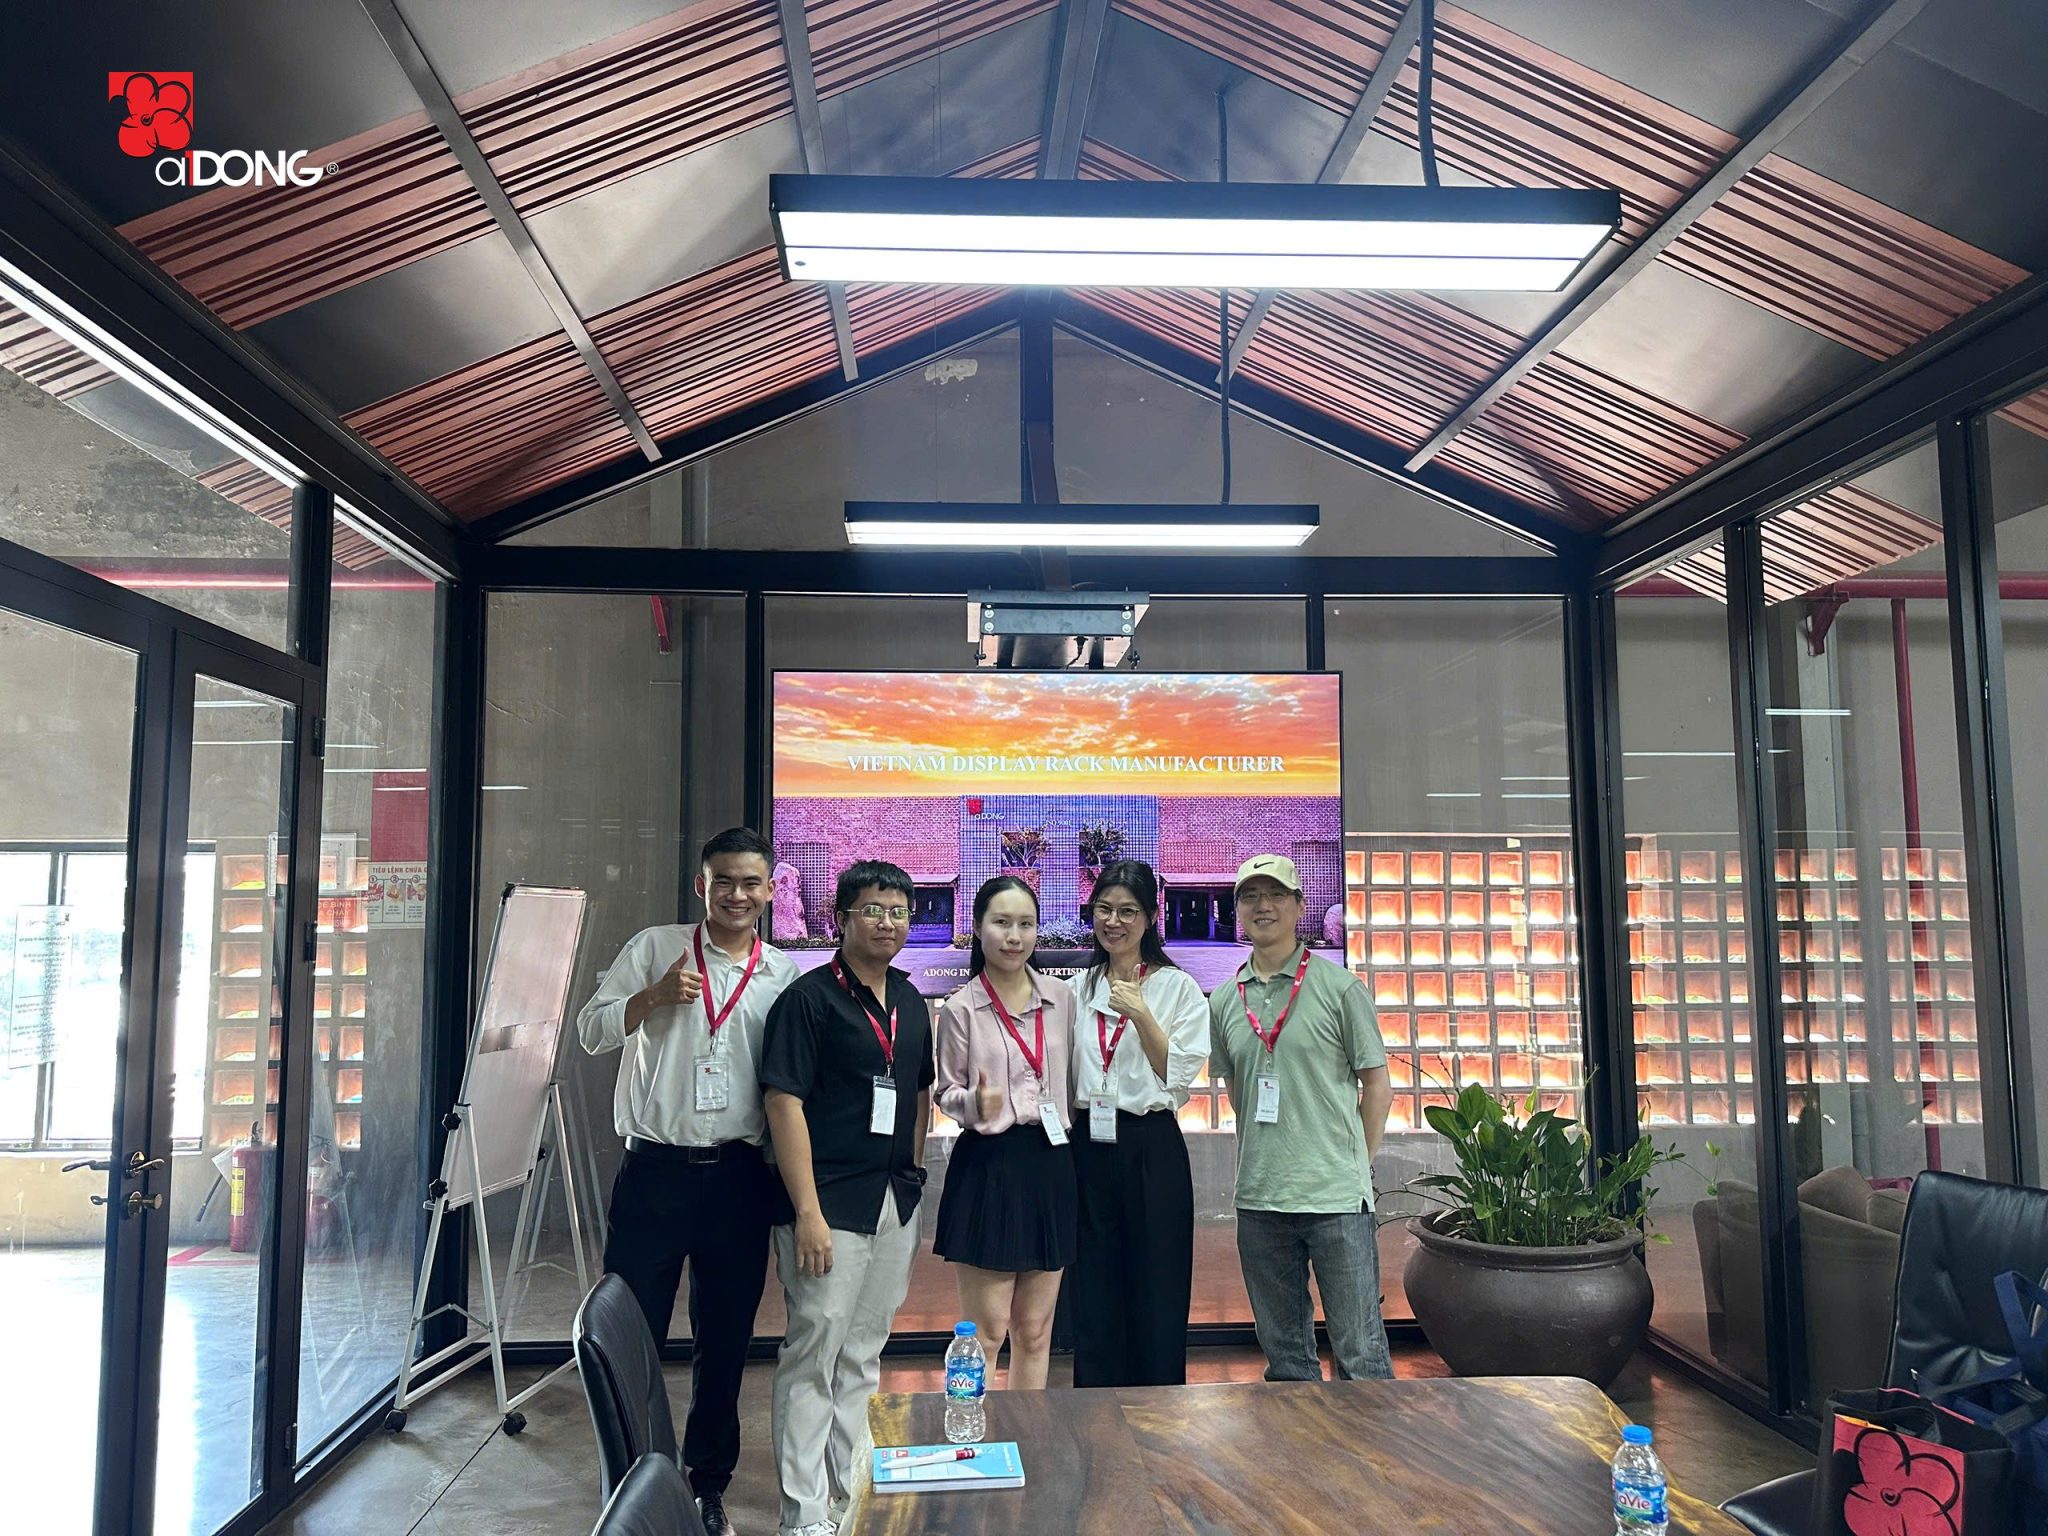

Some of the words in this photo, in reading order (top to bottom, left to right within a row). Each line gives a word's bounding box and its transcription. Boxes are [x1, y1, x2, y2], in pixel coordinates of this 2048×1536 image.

[847, 755, 946, 772] VIETNAM
[952, 755, 1040, 772] DISPLAY
[1045, 755, 1104, 772] RACK
[1110, 755, 1285, 772] MANUFACTURER
[923, 968, 958, 977] ADONG
